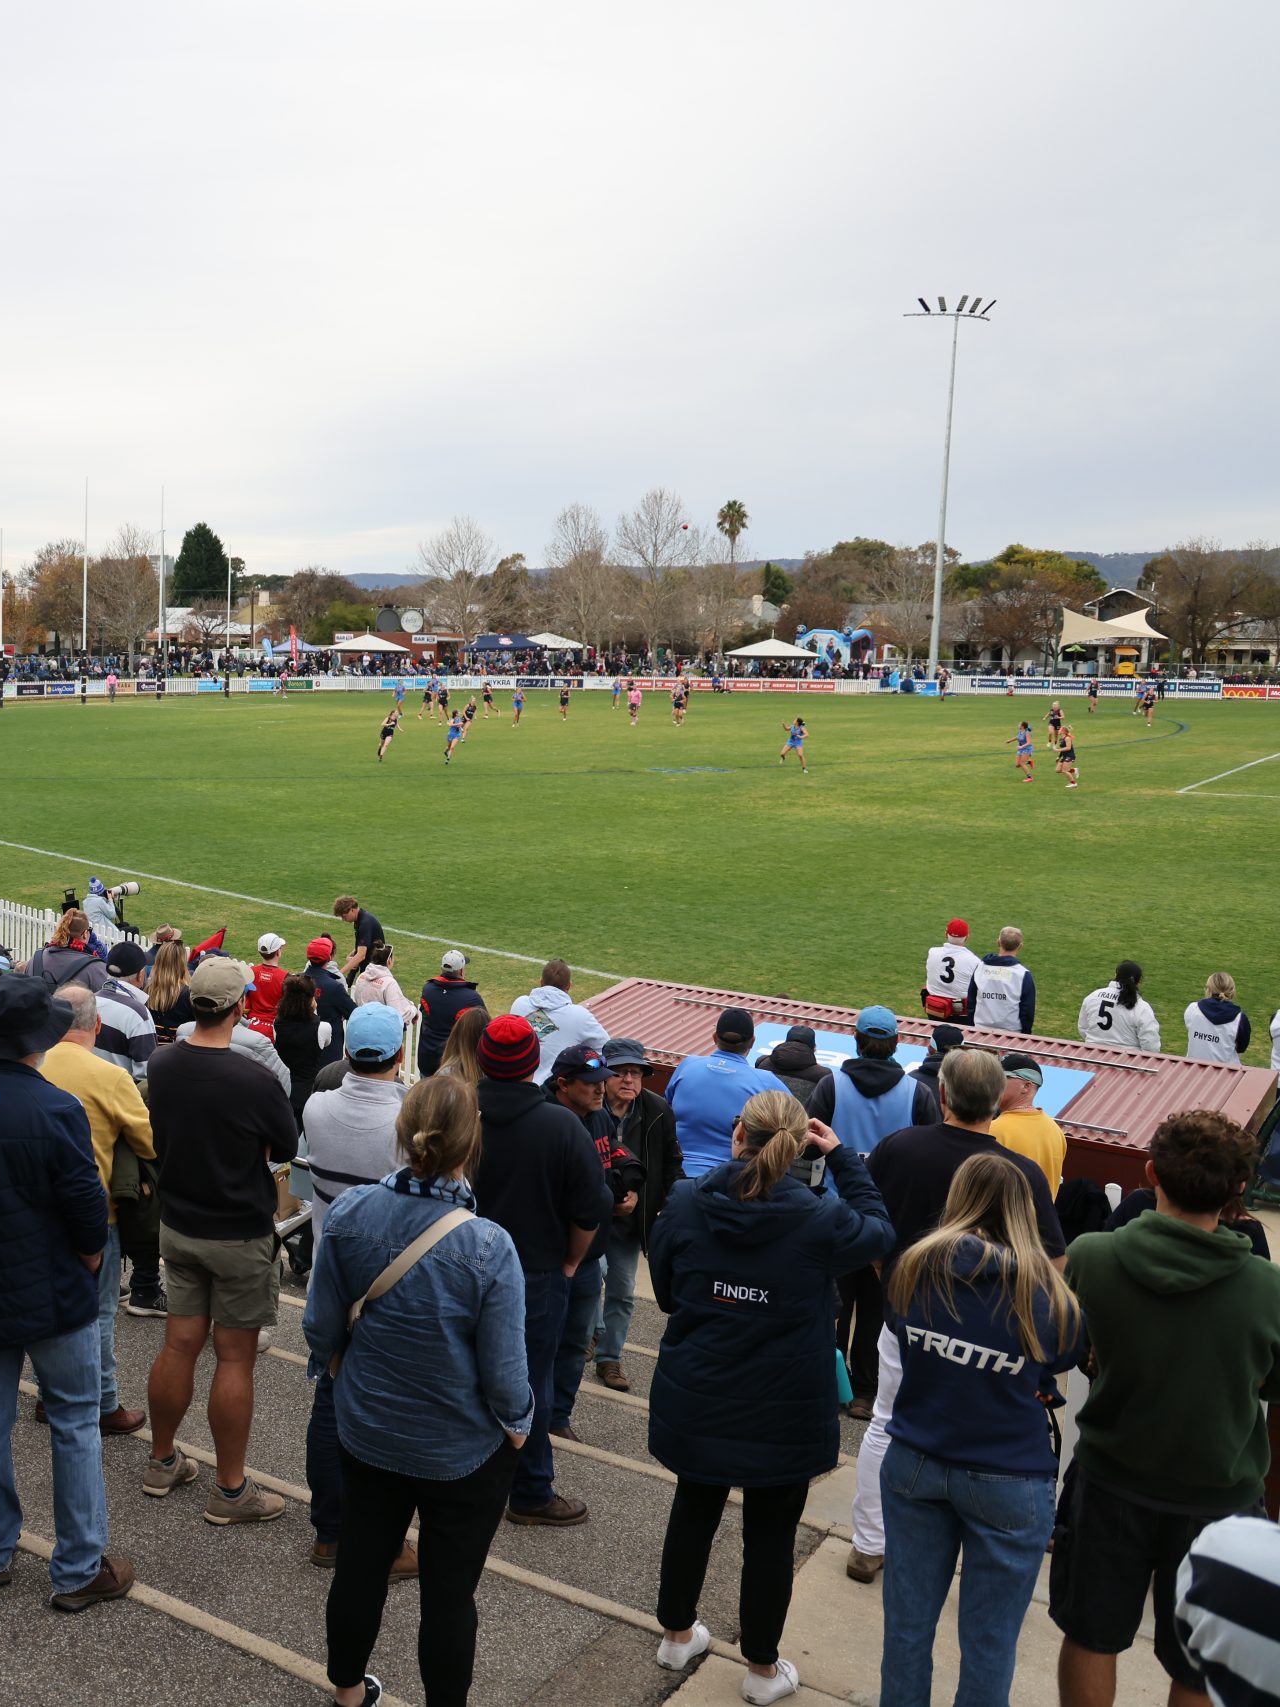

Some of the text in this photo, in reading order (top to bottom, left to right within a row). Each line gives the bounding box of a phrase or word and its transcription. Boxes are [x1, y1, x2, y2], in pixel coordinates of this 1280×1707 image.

[939, 956, 955, 984] 3
[982, 992, 1007, 1001] DOCTOR
[1097, 1000, 1115, 1031] 5
[1193, 1031, 1220, 1043] PHYSIO
[713, 1281, 769, 1304] FINDEX
[905, 1325, 1025, 1375] FROTH
